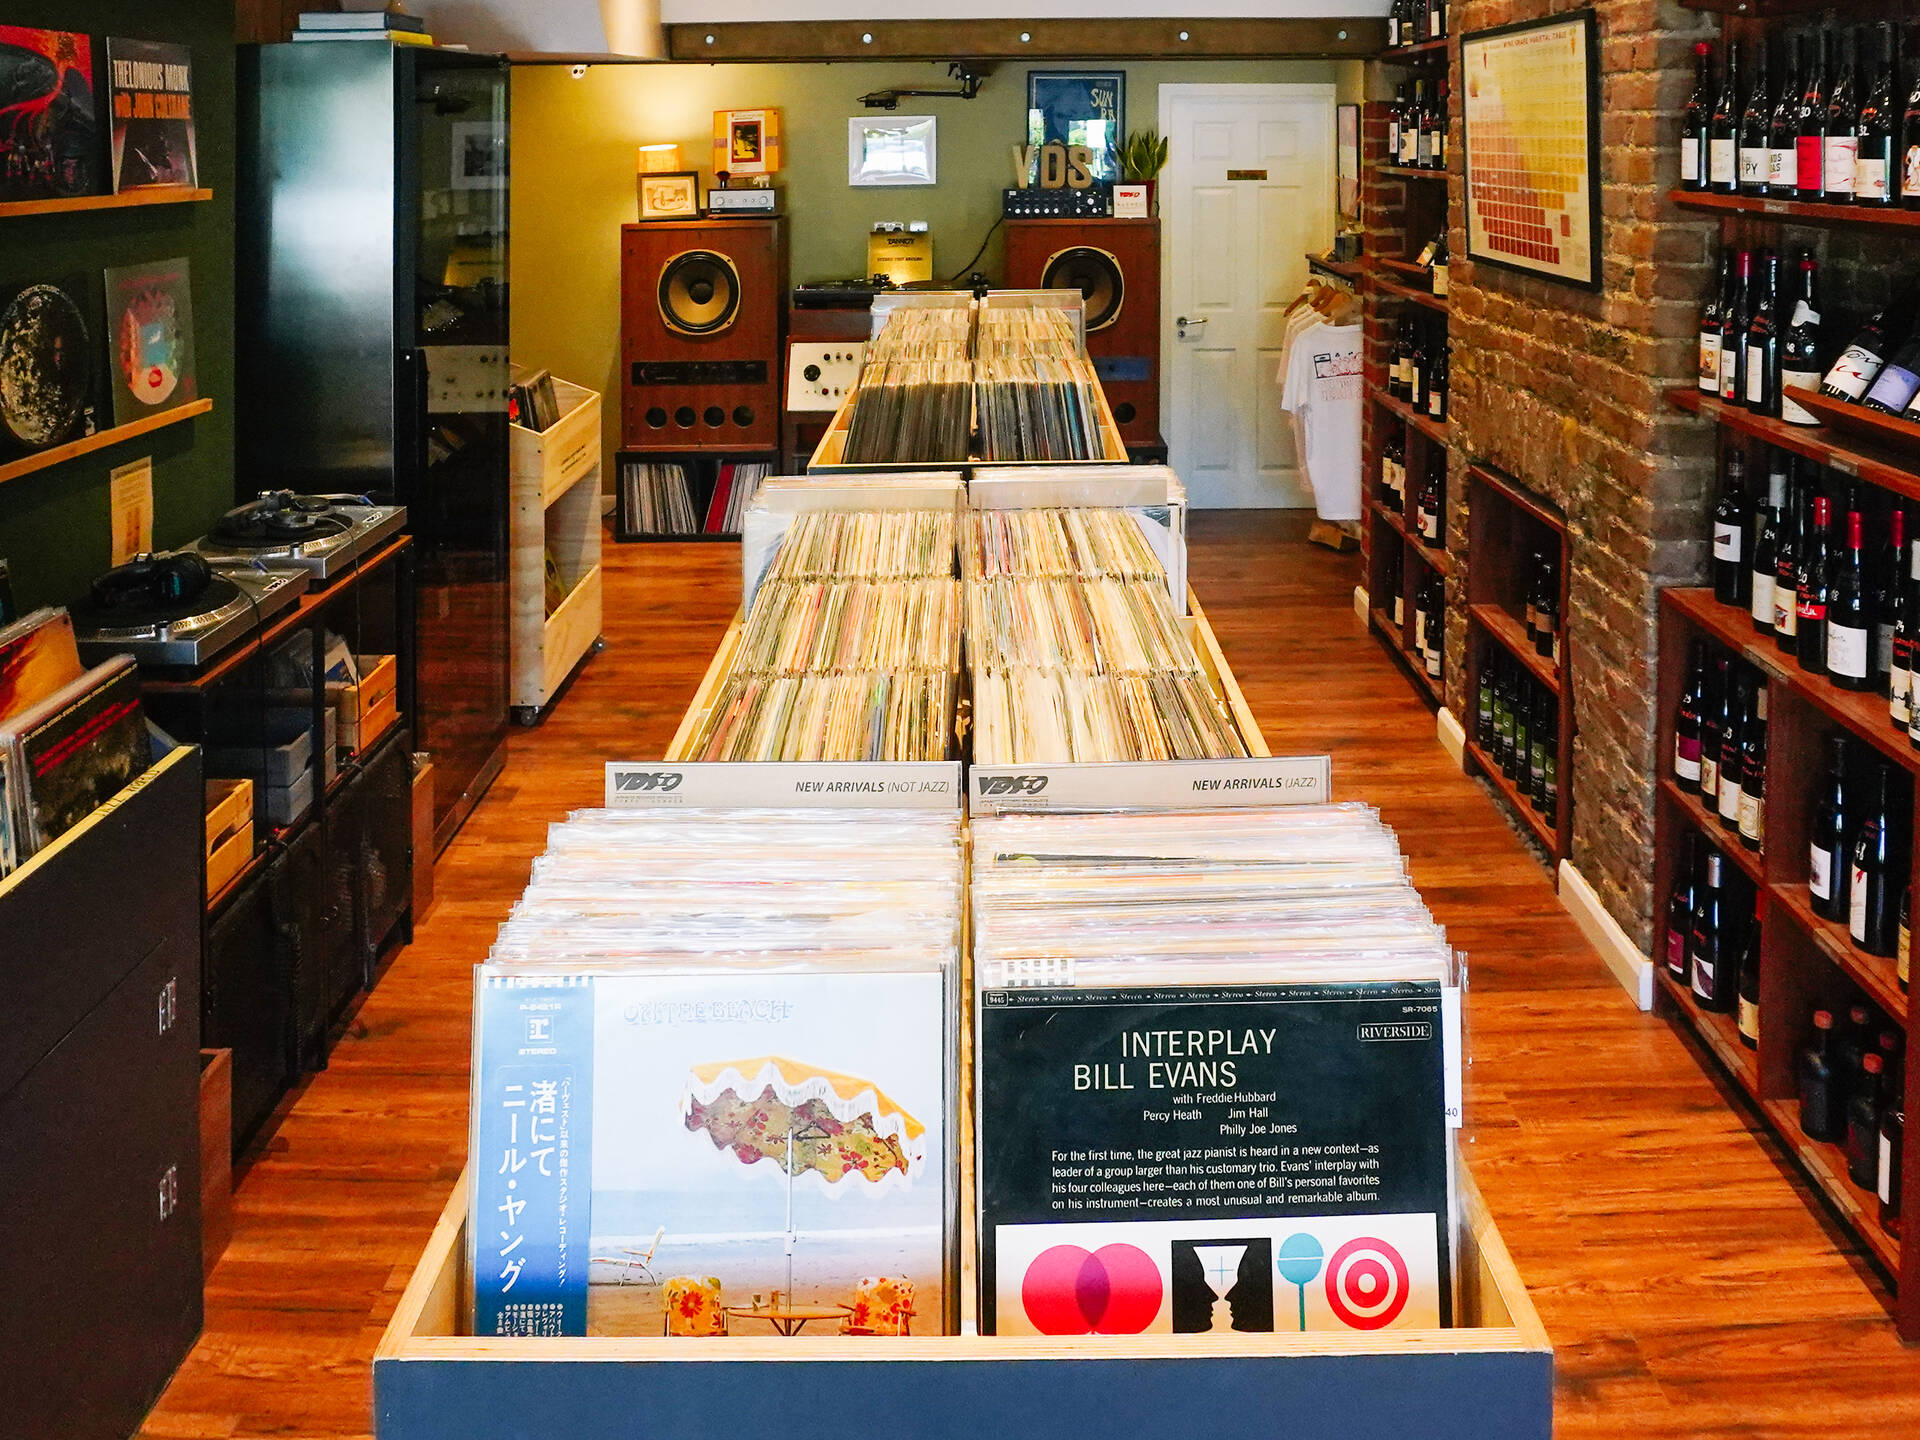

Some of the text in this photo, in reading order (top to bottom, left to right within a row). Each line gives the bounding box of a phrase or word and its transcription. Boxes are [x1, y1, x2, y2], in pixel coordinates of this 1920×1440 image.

[1090, 88, 1114, 107] SUN
[1012, 144, 1093, 189] VDS
[796, 782, 949, 793] NEW ARRIVALS (NOT JAZZ)
[1193, 777, 1316, 790] NEW ARRIVALS (JAZZ)
[660, 1000, 705, 1024] THE
[711, 999, 793, 1021] BEACH
[1361, 1025, 1429, 1038] RIVERSIDE
[1122, 1028, 1277, 1058] INTERPLAY
[1075, 1061, 1238, 1090] BILL EVANS
[1173, 1092, 1276, 1104] with Freddie Hubbard
[1144, 1110, 1201, 1122] Percy Heath
[1228, 1107, 1268, 1118] Jim Hall
[530, 1080, 558, 1177] 渚にて
[1220, 1123, 1297, 1136] Philly Joe Jones
[1052, 1150, 1067, 1162] For
[1070, 1151, 1086, 1161] the
[1088, 1150, 1107, 1161] first
[1110, 1150, 1135, 1161] time,
[1137, 1149, 1153, 1160] the
[1155, 1149, 1181, 1161] great
[1183, 1148, 1202, 1161] jazz
[1205, 1146, 1236, 1160] pianist
[1239, 1147, 1248, 1157] is
[1250, 1145, 1278, 1157] heard
[1280, 1145, 1290, 1156] in
[1293, 1146, 1299, 1156] a
[1302, 1146, 1322, 1155] new
[1052, 1158, 1380, 1179] leader of a group larger than his customary trio. Evans' interplay with
[498, 1084, 527, 1294] ニール・ヤング
[1052, 1182, 1066, 1194] his
[1068, 1182, 1088, 1193] four
[1089, 1182, 1141, 1195] colleagues
[1198, 1179, 1208, 1191] of
[1210, 1179, 1235, 1190] them
[1237, 1180, 1255, 1189] one
[1257, 1177, 1267, 1188] of
[1269, 1176, 1293, 1188] Bill's
[1295, 1175, 1336, 1189] personal
[1338, 1175, 1380, 1186] favorites
[1052, 1199, 1065, 1210] on
[1068, 1198, 1083, 1209] his
[1186, 1198, 1192, 1207] a
[1196, 1196, 1220, 1207] most
[1223, 1194, 1262, 1206] unusual
[1265, 1193, 1284, 1204] and
[1288, 1191, 1343, 1204] remarkable
[1346, 1191, 1380, 1202] album.
